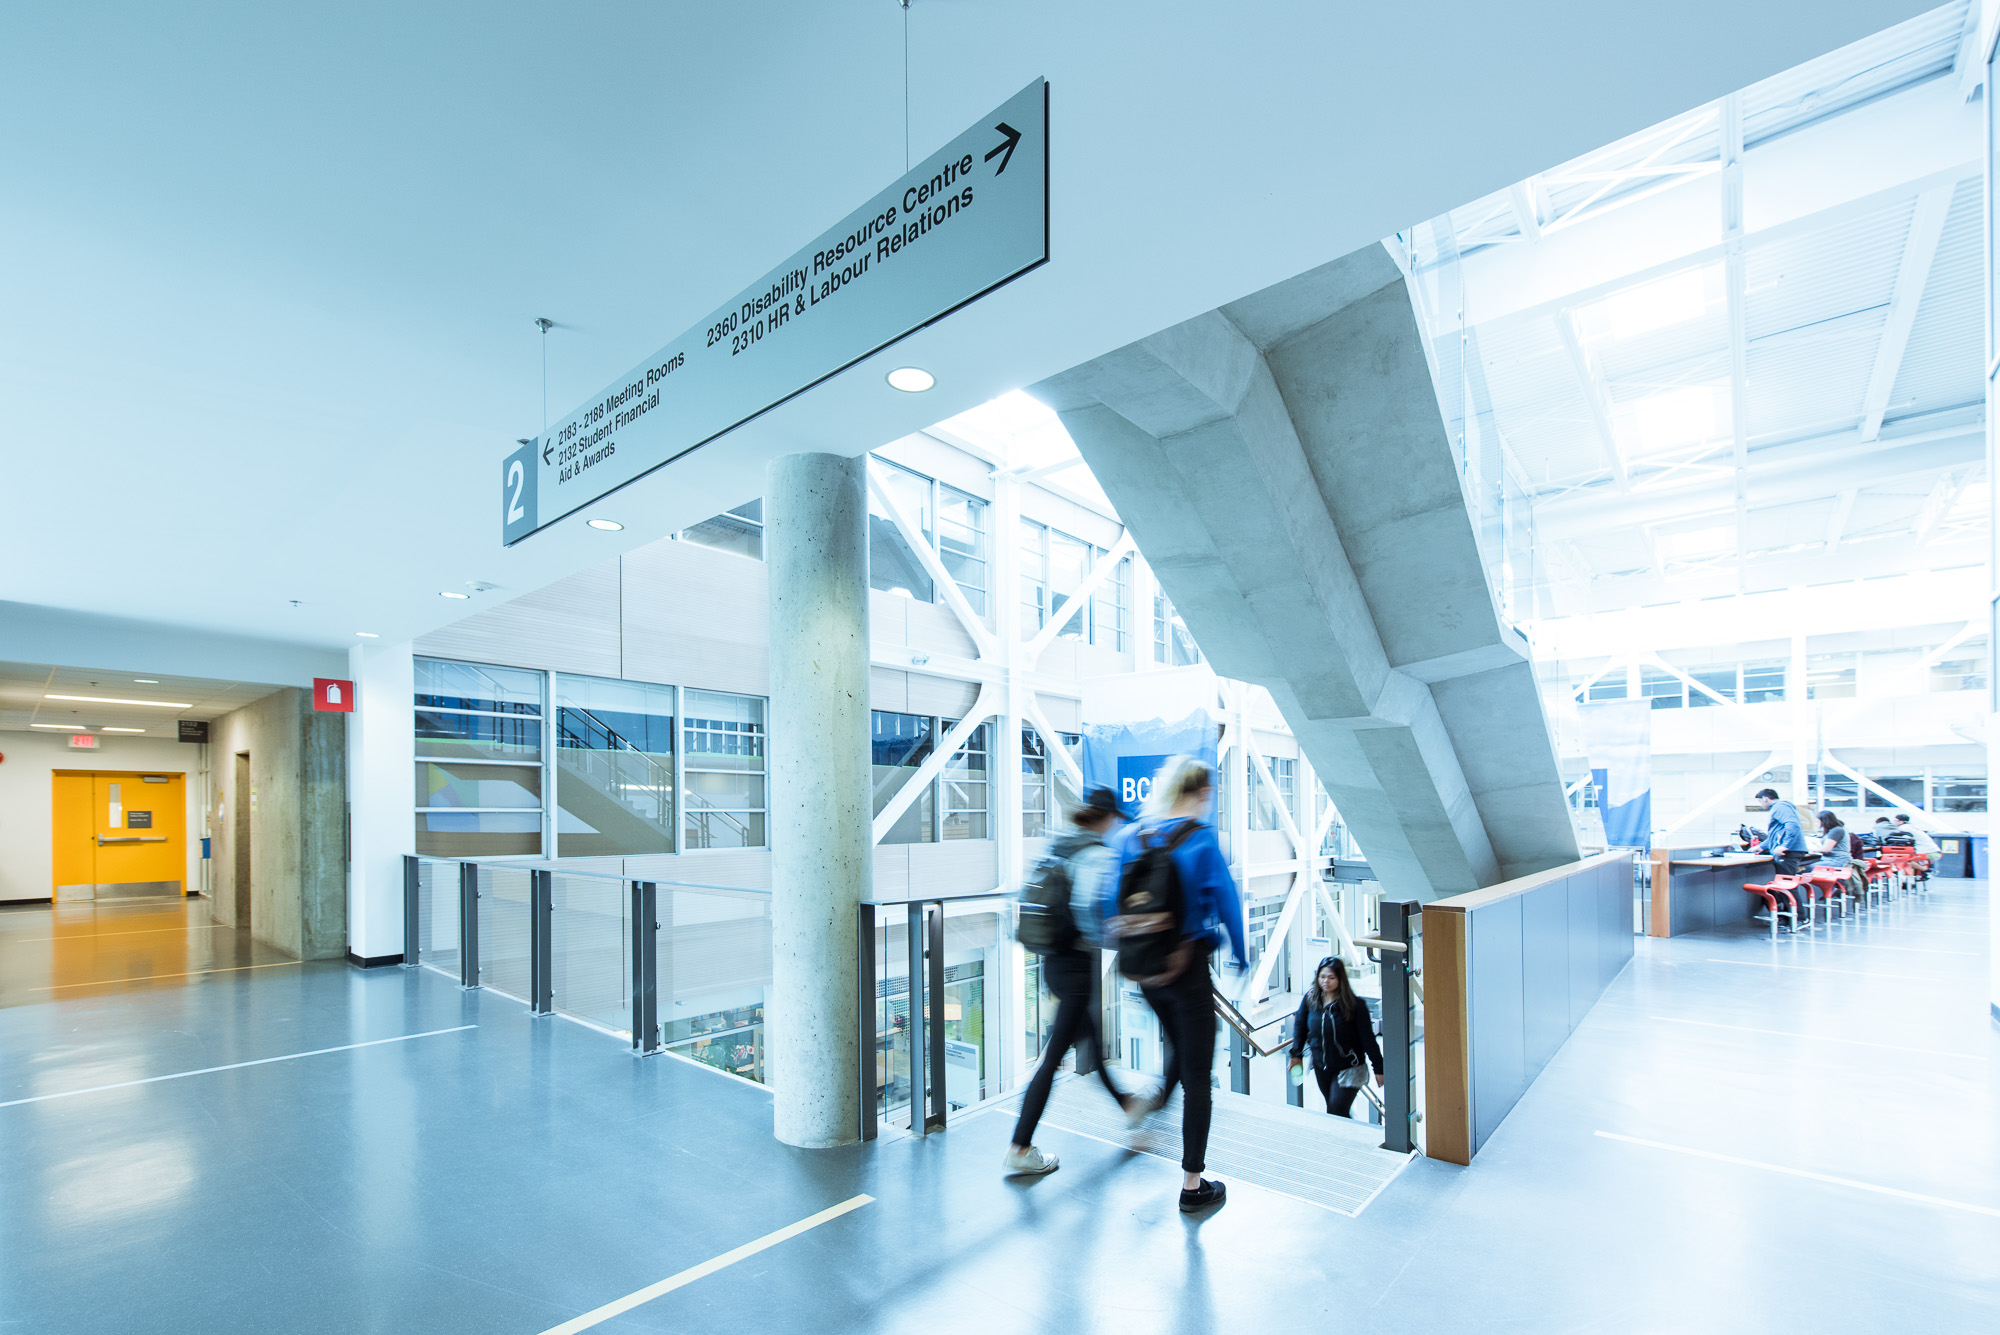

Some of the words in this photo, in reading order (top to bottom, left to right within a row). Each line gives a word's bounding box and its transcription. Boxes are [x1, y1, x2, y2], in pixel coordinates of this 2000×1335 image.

[706, 311, 738, 349] 2360
[741, 265, 809, 325] Disability
[813, 206, 897, 277] Resource
[902, 153, 973, 214] Centre
[731, 319, 764, 357] 2310
[767, 302, 790, 334] HR
[794, 292, 807, 316] &
[810, 251, 872, 307] Labour
[876, 185, 974, 264] Relations
[558, 421, 578, 447] 2183
[583, 402, 605, 430] 2188
[606, 378, 644, 415] Meeting
[646, 351, 685, 389] Rooms
[558, 441, 578, 467] 2132
[578, 419, 613, 454] Student
[615, 387, 660, 432] Financial
[507, 459, 525, 526] 2
[558, 463, 573, 486] Aid
[573, 459, 581, 476] &
[582, 440, 616, 472] Awards
